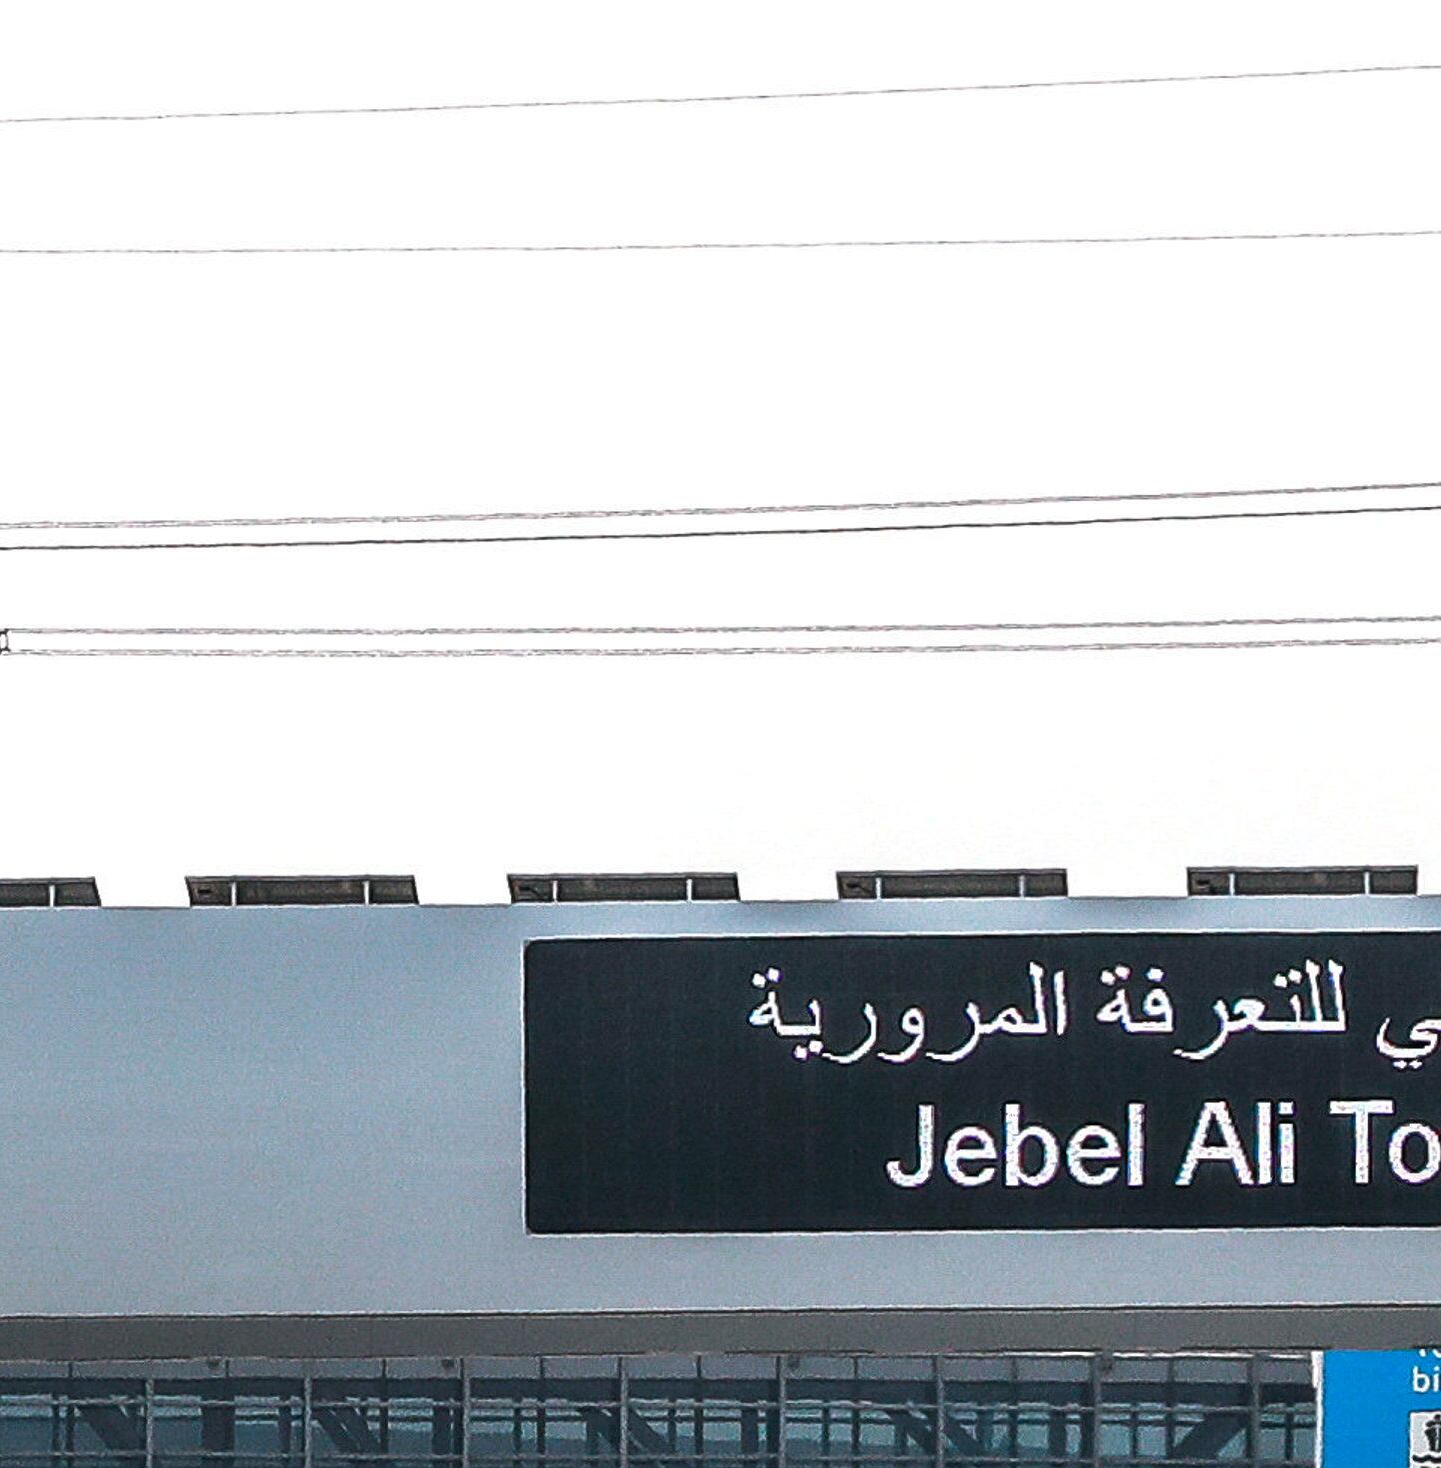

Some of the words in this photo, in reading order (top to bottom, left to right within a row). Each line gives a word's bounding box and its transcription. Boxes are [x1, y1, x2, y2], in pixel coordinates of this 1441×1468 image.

[748, 962, 1065, 1063] المرورية
[1095, 960, 1346, 1061] للتعرفة
[886, 1103, 1145, 1187] Jebel
[1174, 1100, 1294, 1186] Ali
